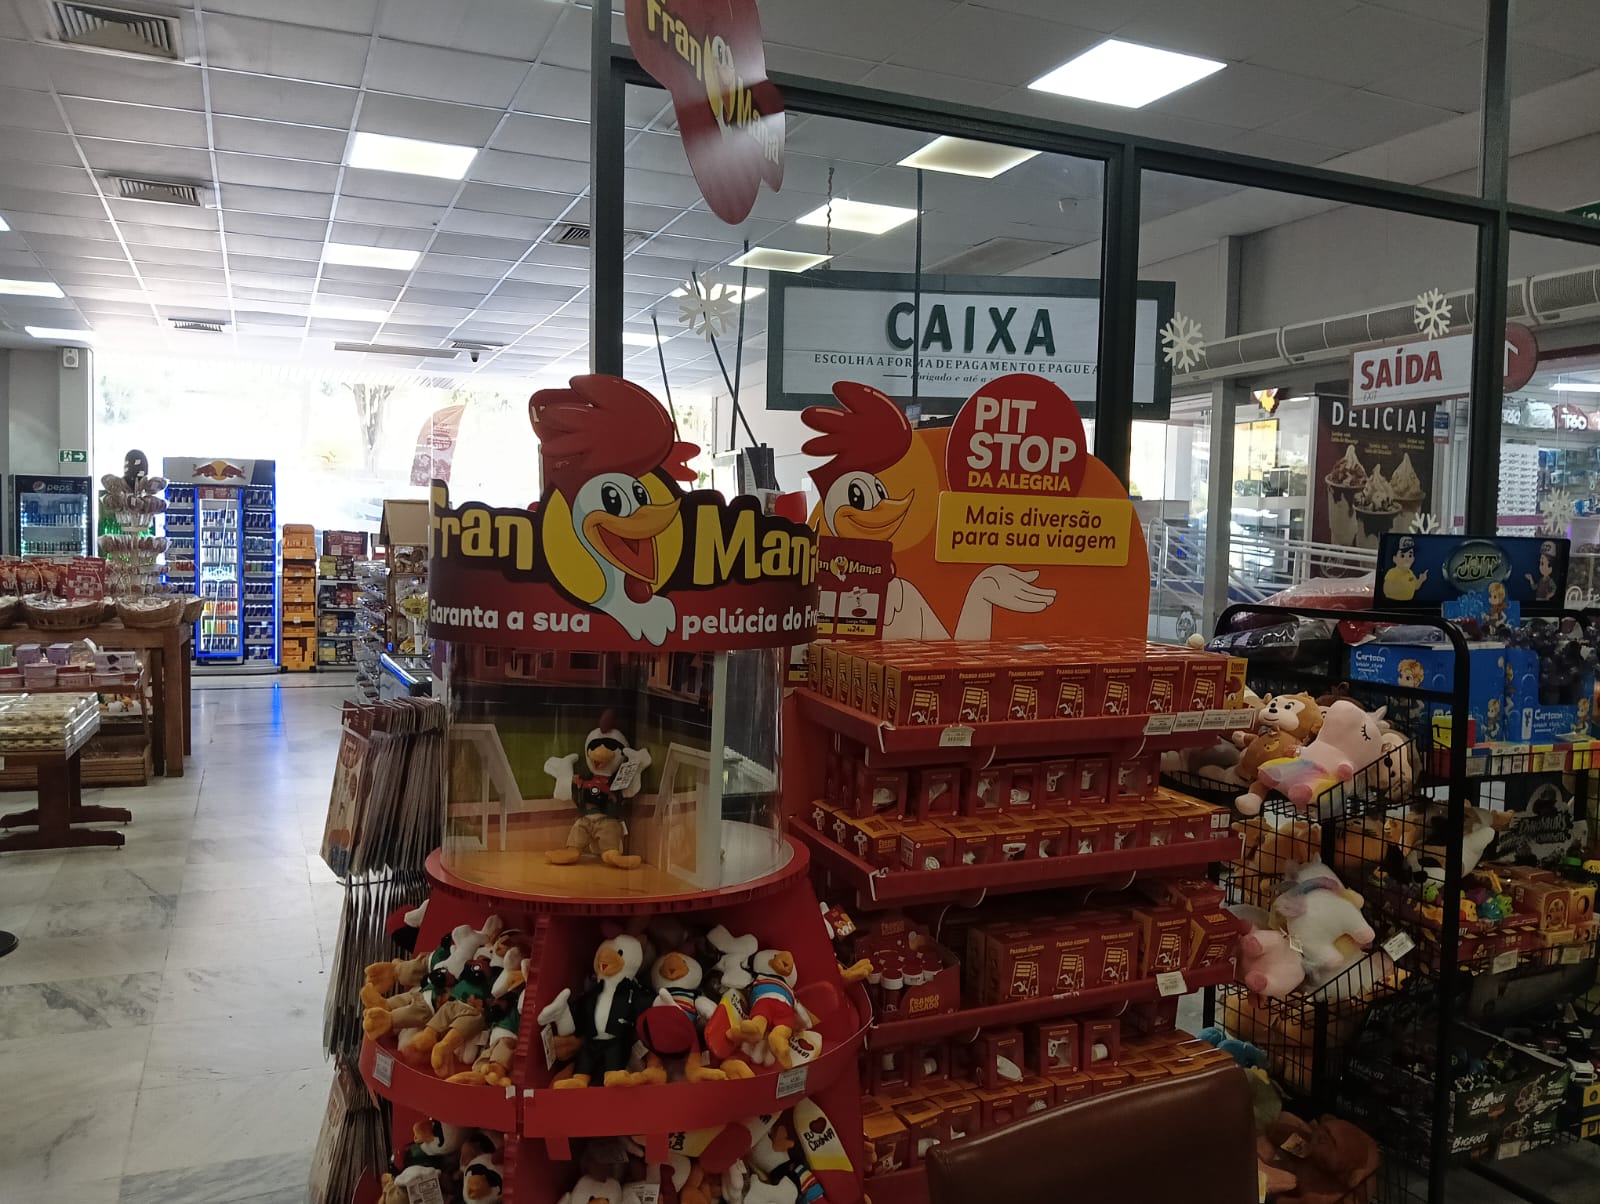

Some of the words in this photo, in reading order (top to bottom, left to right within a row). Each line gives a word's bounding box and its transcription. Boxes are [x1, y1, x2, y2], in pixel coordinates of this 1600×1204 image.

[646, 0, 702, 81] Fran
[886, 301, 1056, 356] CAIXA
[814, 353, 874, 367] ESCOLHA
[887, 357, 933, 368] FORMA
[936, 359, 952, 370] DE
[955, 359, 1036, 373] PAGAMENTO
[1038, 362, 1046, 373] E
[1048, 362, 1091, 375] PAGUE
[1360, 348, 1442, 391] SAÍDA
[974, 396, 1037, 434] PIT
[967, 432, 1077, 474] STOP
[47, 484, 73, 493] pepsi
[968, 471, 993, 488] DA
[996, 472, 1071, 492] ALEGRIA
[965, 505, 1014, 526] Mais
[1020, 507, 1102, 529] diversão
[951, 530, 999, 549] para
[1005, 532, 1040, 547] sua
[1046, 529, 1117, 553] viagem
[848, 560, 882, 575] Mania
[430, 599, 499, 629] Garanta
[506, 610, 524, 630] a
[532, 610, 590, 634] sua
[682, 607, 778, 641] pelúcia
[782, 605, 802, 632] do
[1452, 1132, 1488, 1149] BIGFOOT
